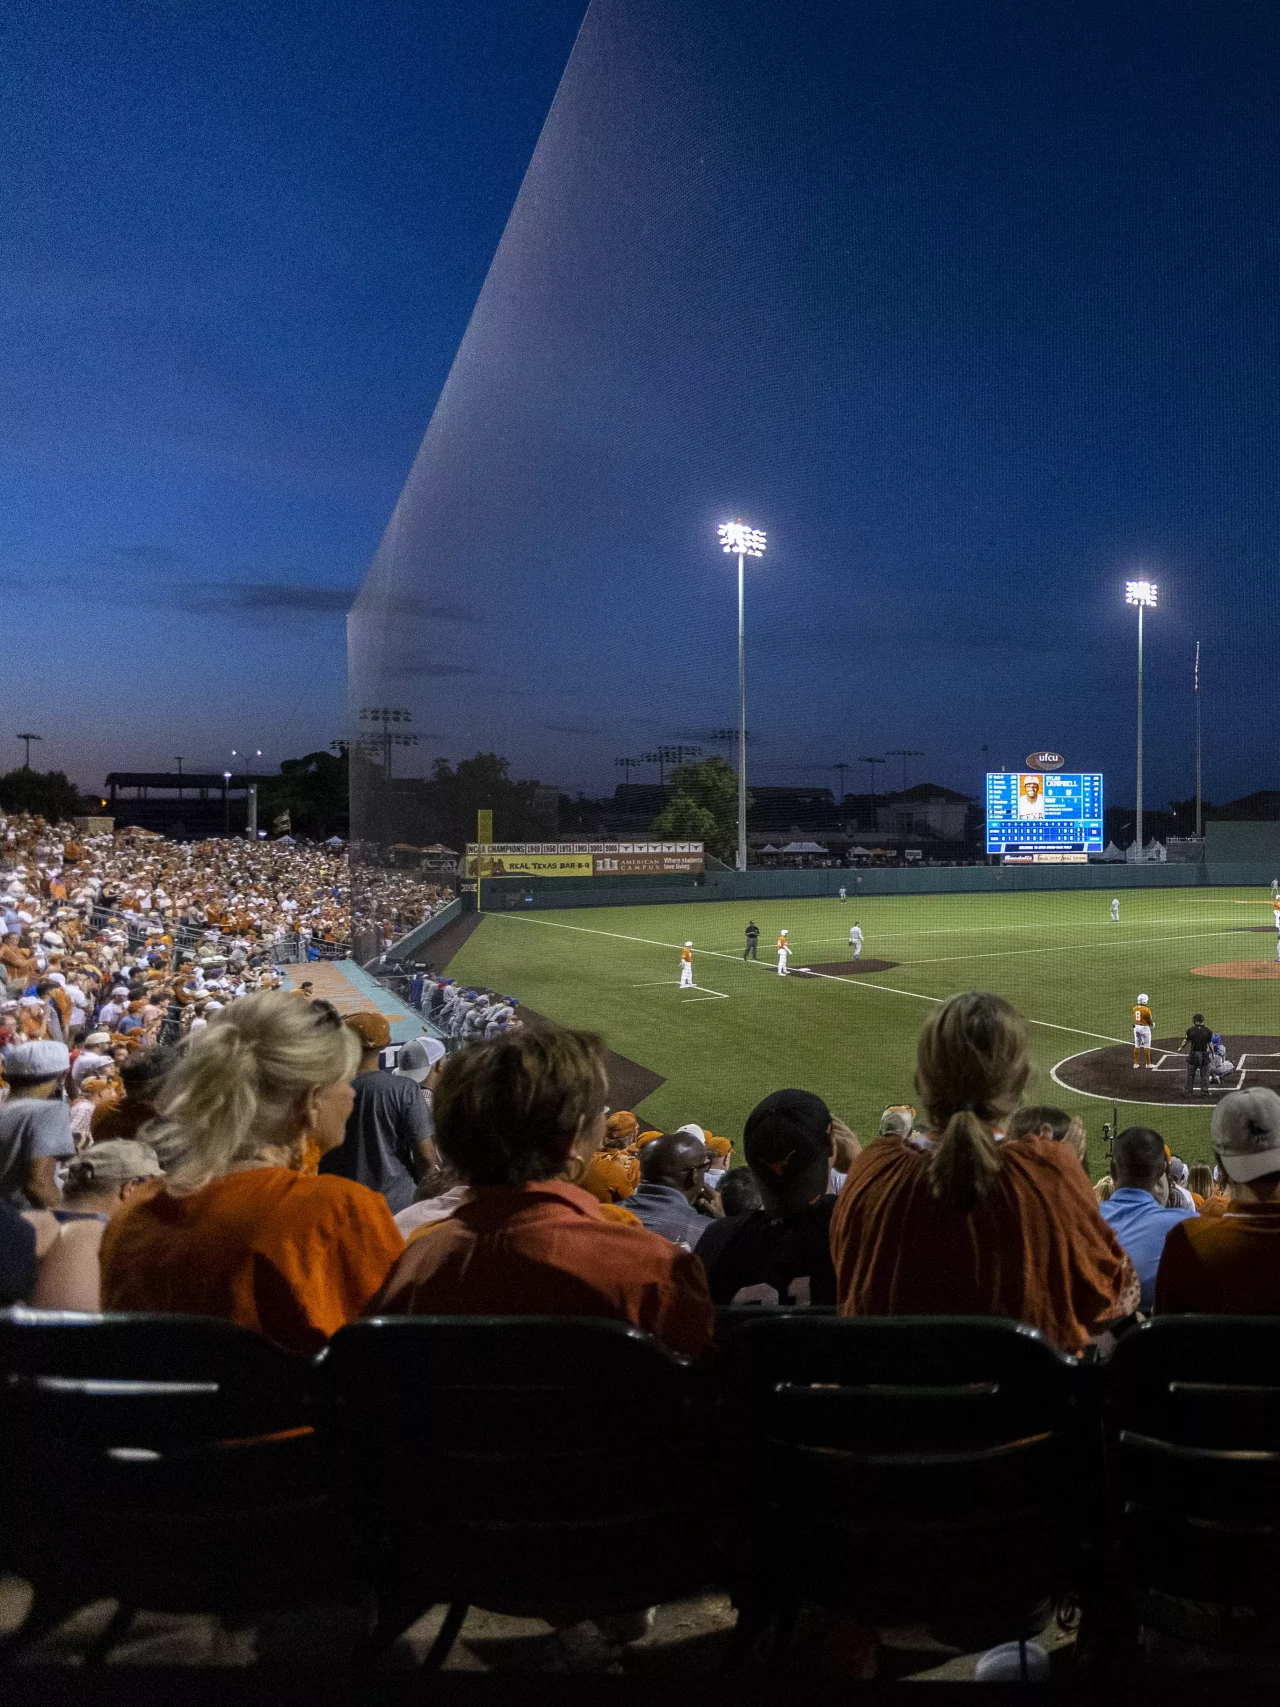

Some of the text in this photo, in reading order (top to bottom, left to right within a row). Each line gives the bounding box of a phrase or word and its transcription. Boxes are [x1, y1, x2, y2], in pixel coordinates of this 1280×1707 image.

[1039, 753, 1058, 762] ufcu
[468, 845, 487, 854] NCA
[487, 844, 525, 853] CHAMPIONS
[532, 862, 557, 870] TEXAS
[1135, 1010, 1141, 1021] 8
